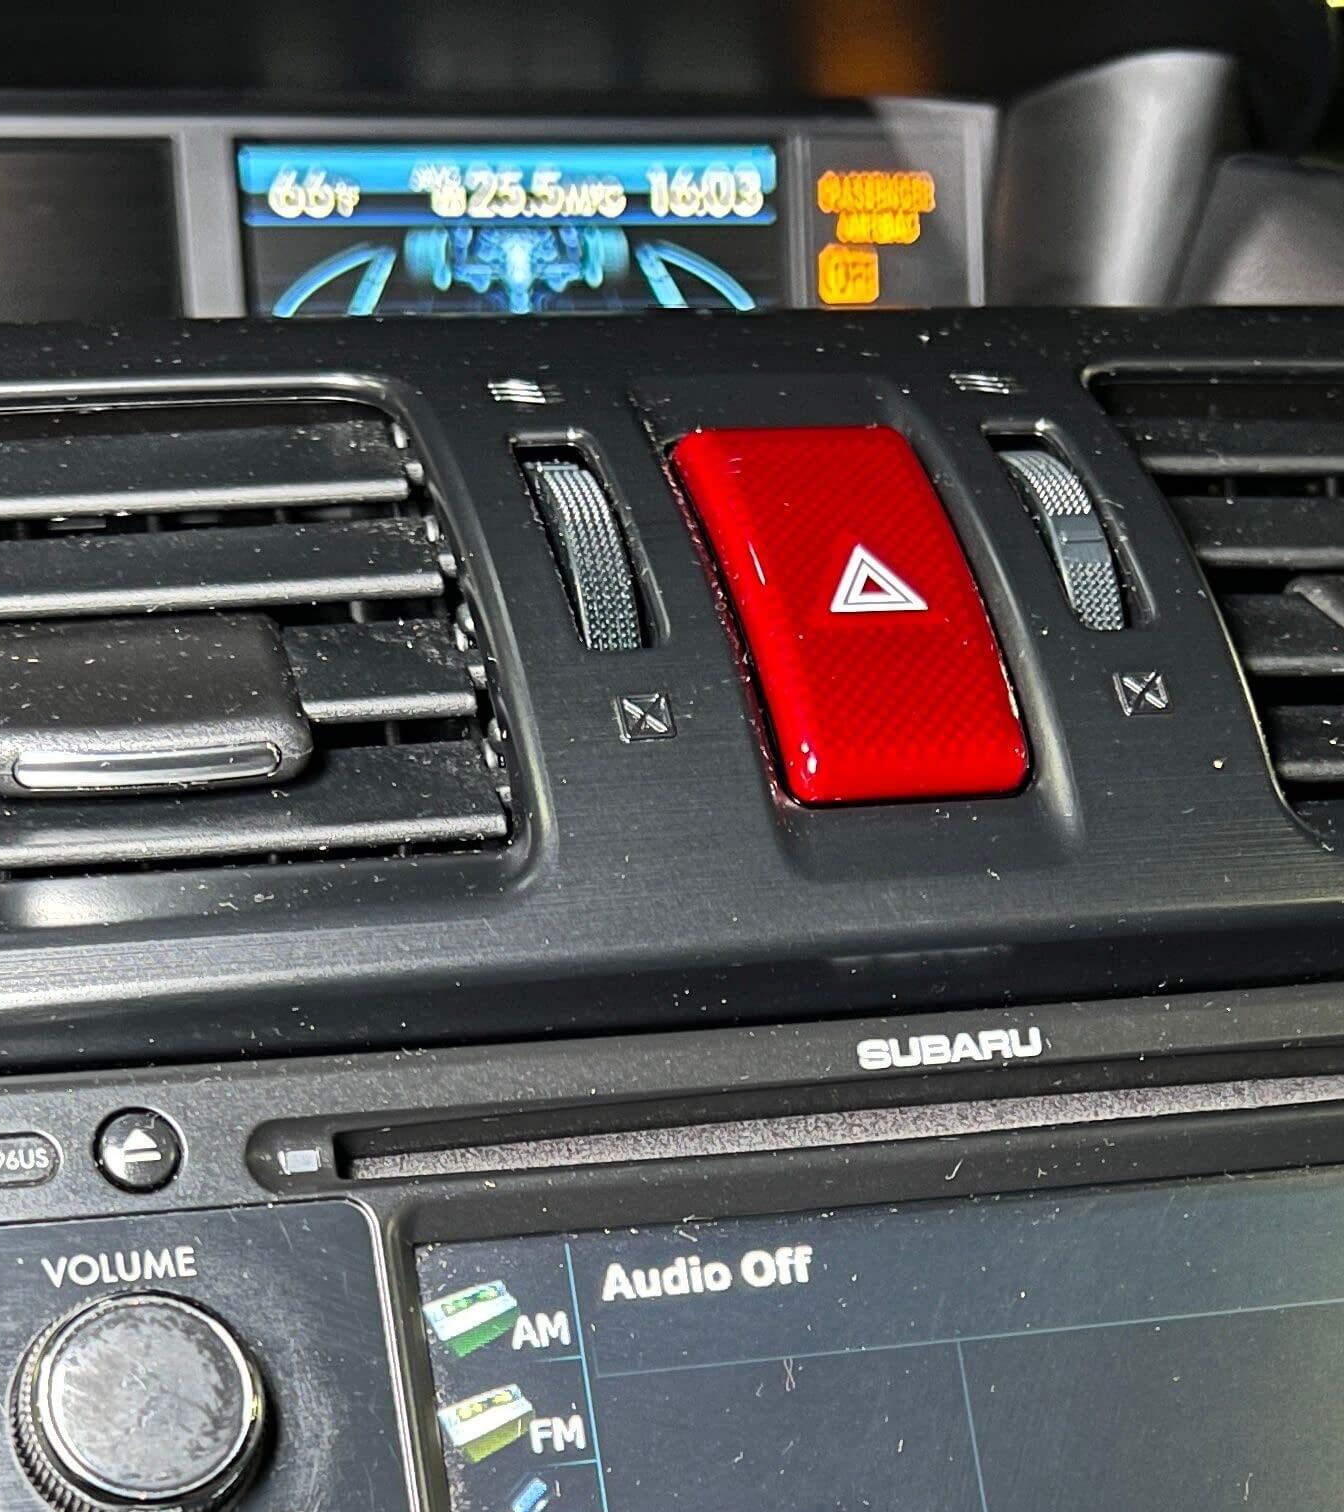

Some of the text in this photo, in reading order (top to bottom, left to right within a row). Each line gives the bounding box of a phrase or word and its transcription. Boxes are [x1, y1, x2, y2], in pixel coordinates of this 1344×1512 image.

[856, 1027, 1043, 1070] SUBARU
[41, 1245, 197, 1288] VOLUME
[601, 1245, 813, 1301] Audio Off
[511, 1311, 571, 1350] AM
[529, 1414, 586, 1454] FM
